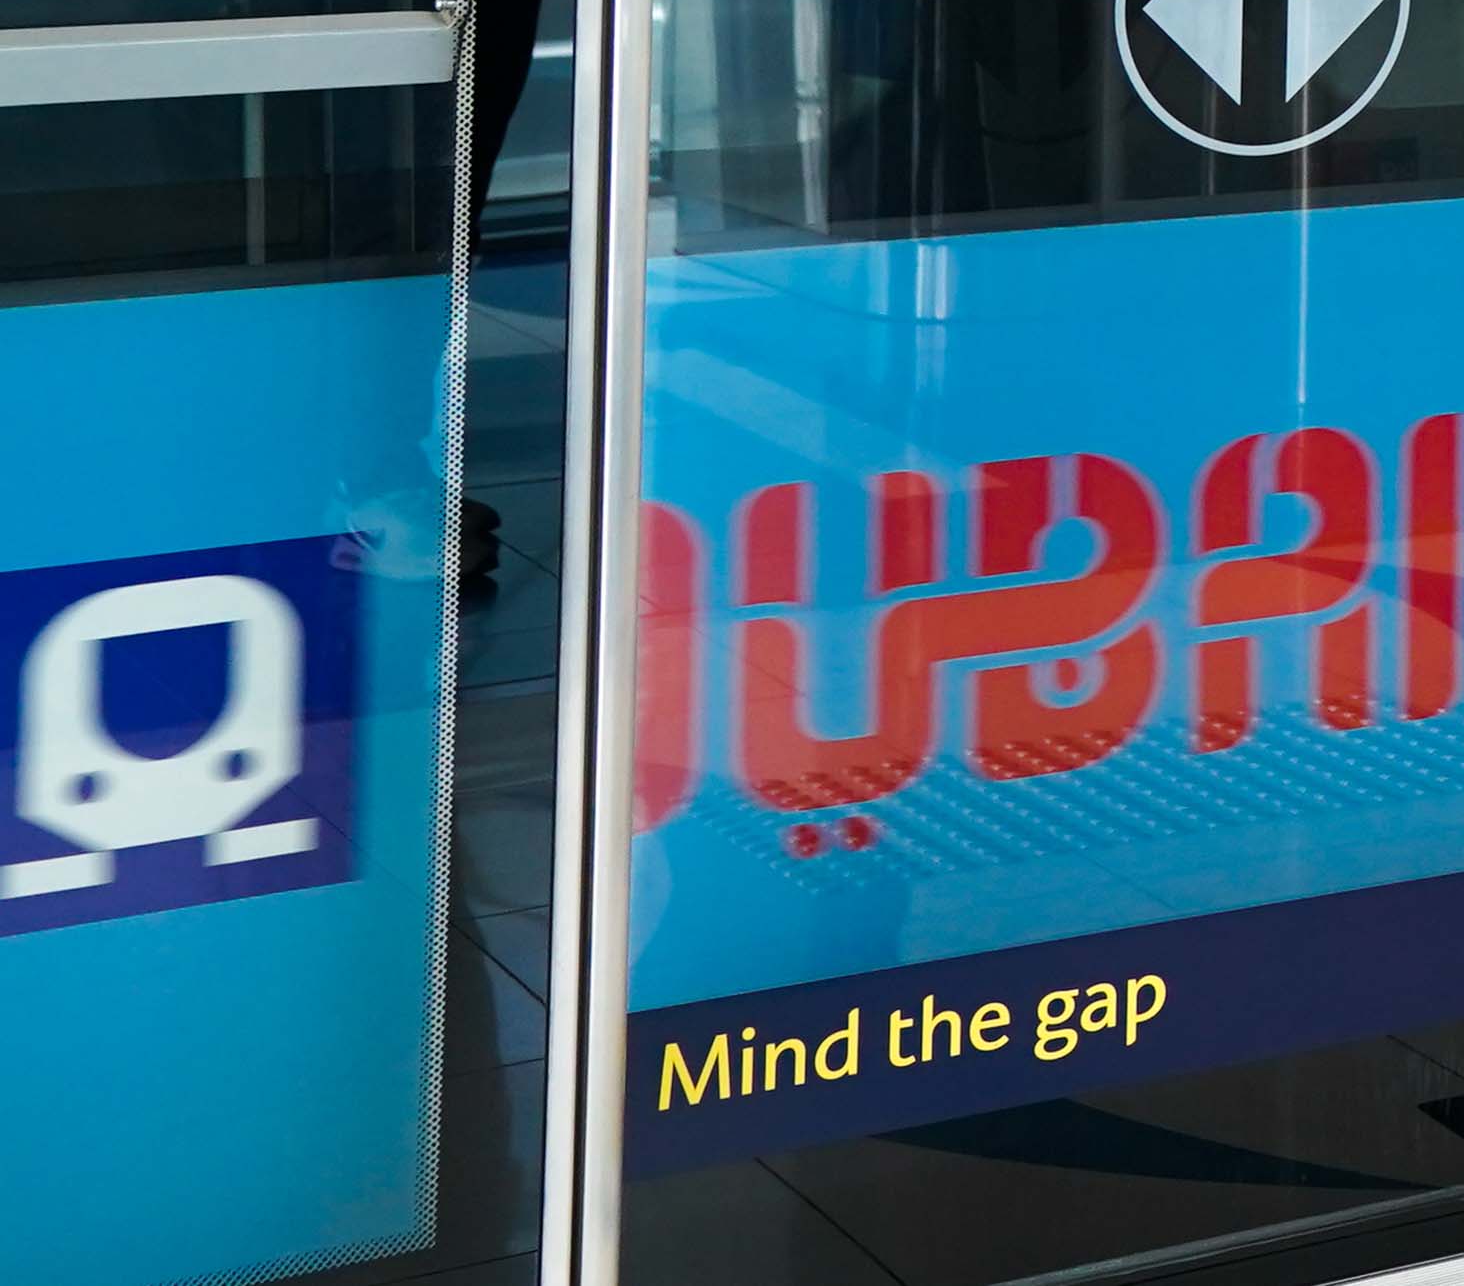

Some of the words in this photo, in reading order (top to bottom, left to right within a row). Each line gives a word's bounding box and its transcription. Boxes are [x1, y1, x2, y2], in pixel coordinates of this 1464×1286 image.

[656, 1002, 863, 1113] Mind
[886, 990, 1012, 1068] the
[1034, 969, 1170, 1064] gap
